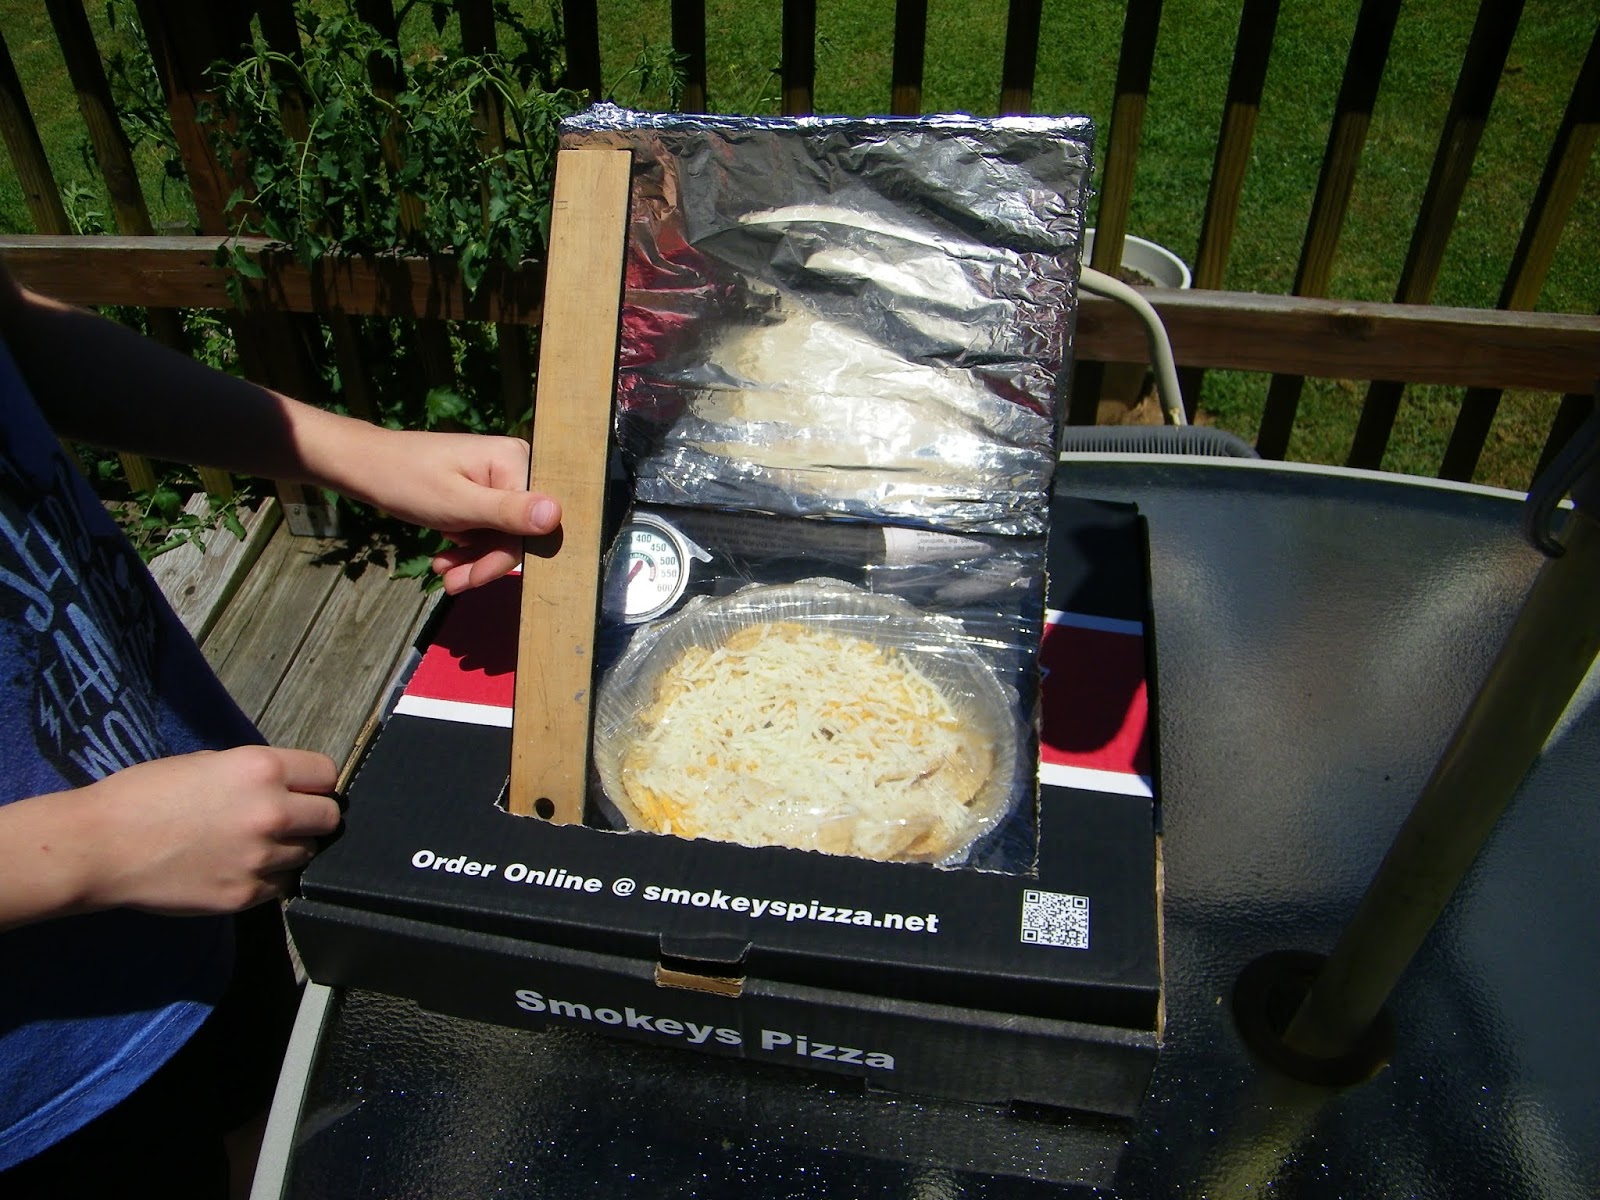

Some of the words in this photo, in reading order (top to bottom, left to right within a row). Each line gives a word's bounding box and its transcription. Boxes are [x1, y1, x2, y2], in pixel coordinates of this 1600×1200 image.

[636, 534, 652, 543] 400
[650, 543, 667, 552] 450
[660, 556, 676, 565] 500
[661, 569, 677, 578] 550
[657, 583, 673, 592] 600
[411, 849, 497, 878] Order
[503, 863, 603, 893] Online
[611, 877, 636, 897] @
[642, 885, 940, 934] smokeyspizza.net
[515, 989, 742, 1045] Smokeys
[761, 1029, 895, 1070] Pizza
